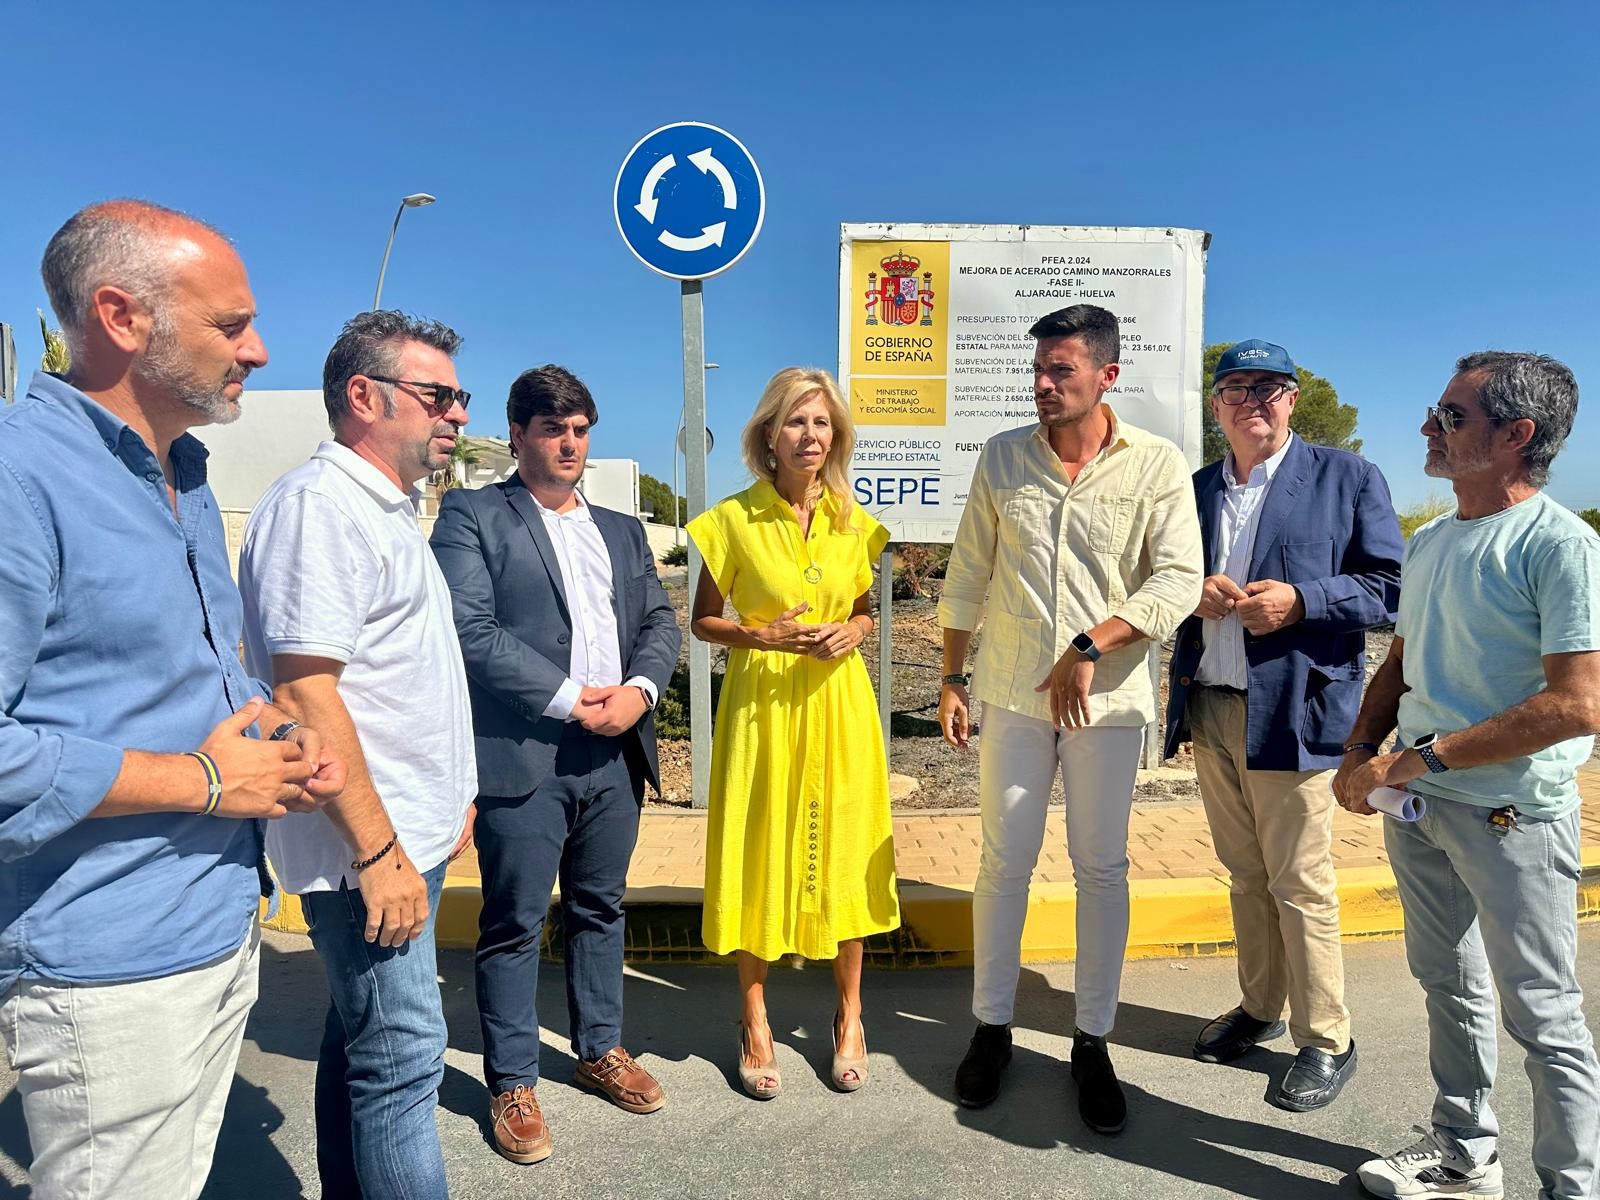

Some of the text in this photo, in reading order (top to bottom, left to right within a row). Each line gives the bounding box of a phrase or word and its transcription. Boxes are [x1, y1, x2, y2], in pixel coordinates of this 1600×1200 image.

[1041, 256, 1091, 265] PFEA 2.024
[959, 266, 1172, 277] MEJORA DE ACERADO CAMINO MANZORRALES
[1046, 278, 1074, 287] -FASE
[1014, 289, 1072, 298] ALJARAQUE
[1079, 289, 1116, 298] HUELVA
[957, 315, 1017, 324] PRESUPUESTO
[1019, 315, 1041, 324] TOTA
[955, 332, 1006, 341] SUBVENCIÓN
[1007, 333, 1022, 341] DEL
[1119, 334, 1142, 342] PLEO
[865, 337, 933, 348] GOBIERNO
[1131, 343, 1172, 352] 23.561,07€
[865, 349, 933, 362] DE ESPAÑA
[954, 357, 1005, 366] SUBVENCIÓN
[1006, 358, 1017, 366] DE
[1018, 358, 1028, 366] LA
[1118, 358, 1135, 366] ARA
[954, 367, 1036, 375] MATERIALES: 7.951,86
[876, 388, 918, 396] MINISTERIO
[954, 385, 1004, 393] SUBVENCIÓN
[1124, 386, 1145, 394] PARA
[876, 397, 920, 406] DE TRABAJO
[1004, 395, 1036, 403] 2.650,62
[866, 405, 907, 414] ECONOMÍA
[954, 409, 1039, 418] APORTACIÓN MUNICIPA
[854, 437, 941, 449] SERVICIO PÚBLICO
[955, 442, 985, 452] FUENT
[854, 452, 941, 462] DE EMPLEO ESTATAL
[854, 476, 941, 506] SEPE
